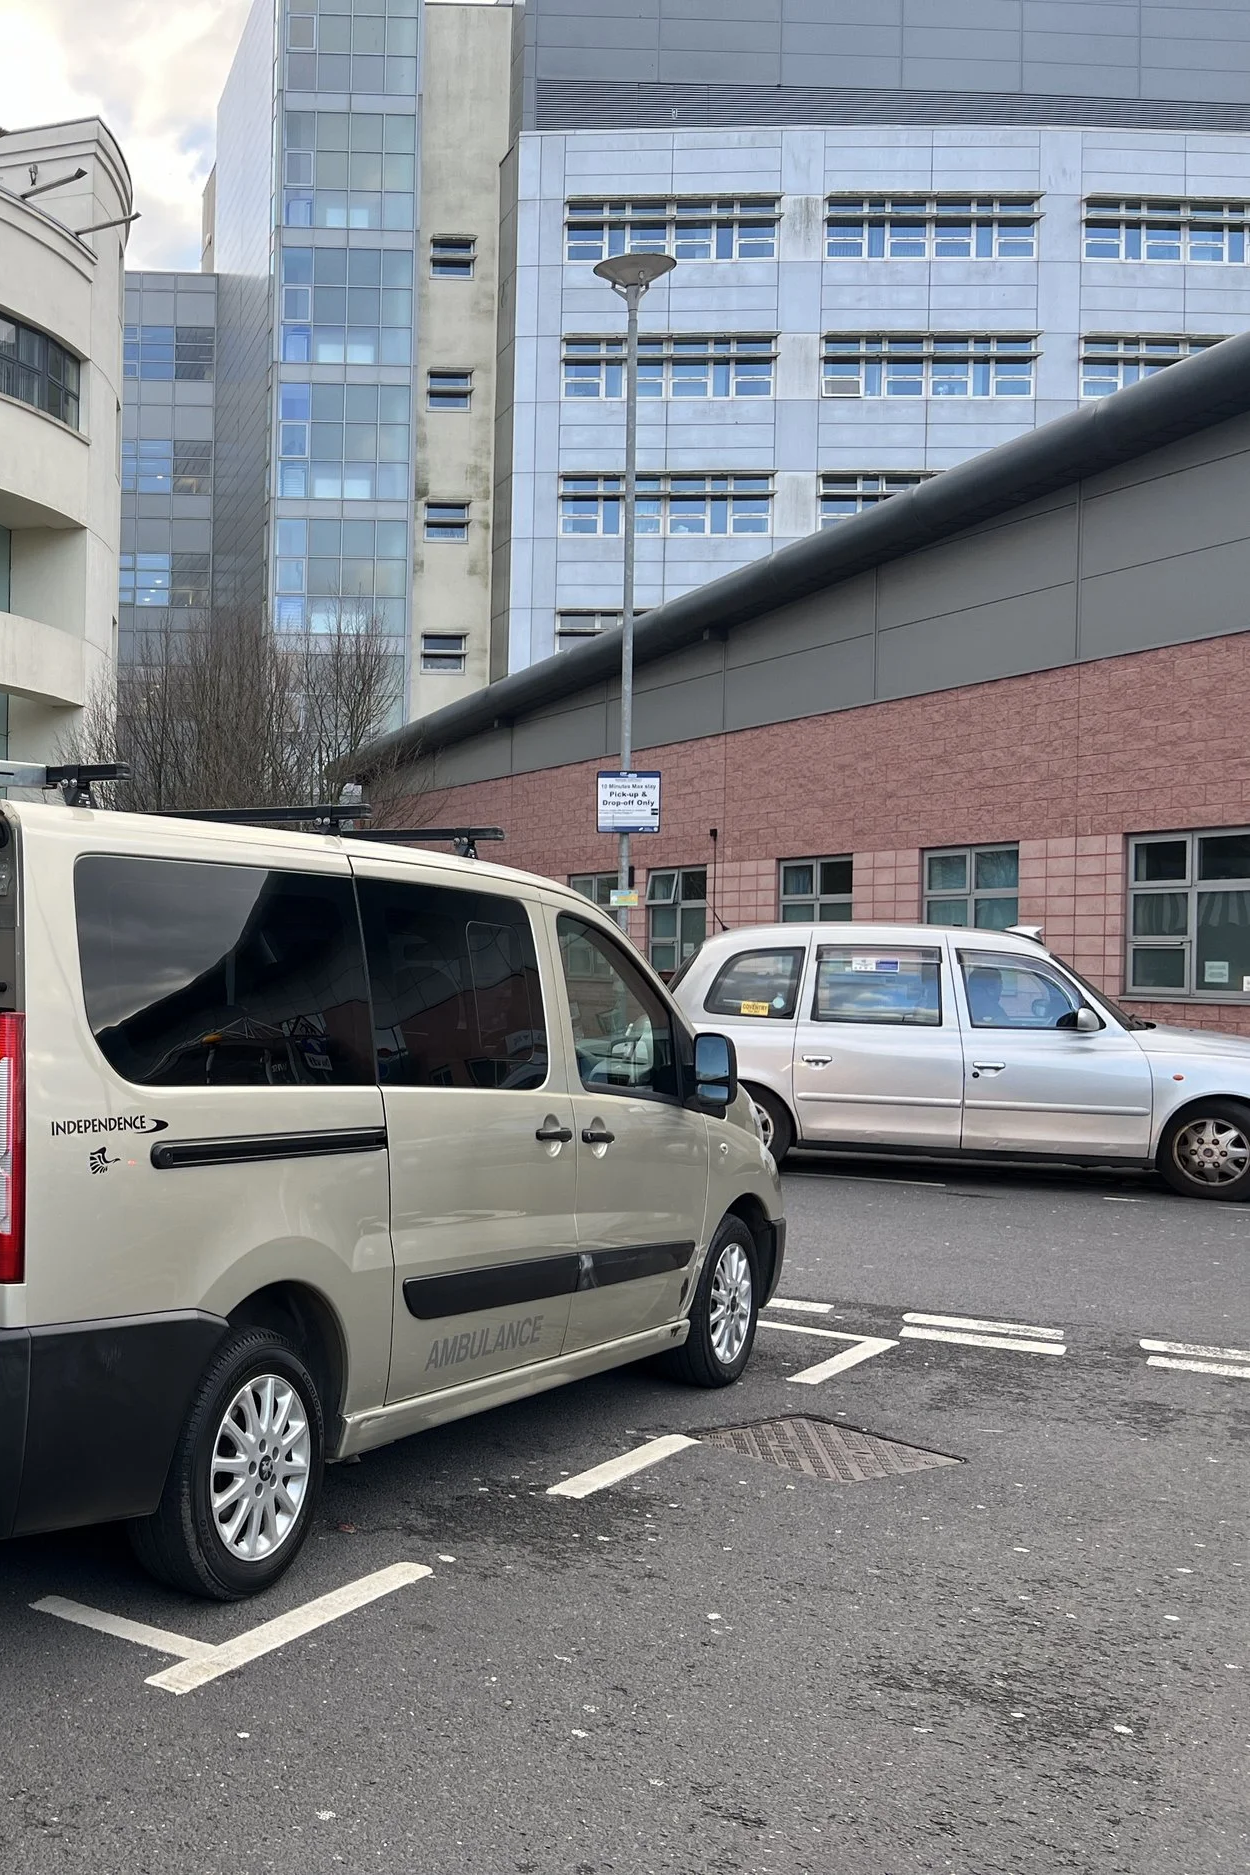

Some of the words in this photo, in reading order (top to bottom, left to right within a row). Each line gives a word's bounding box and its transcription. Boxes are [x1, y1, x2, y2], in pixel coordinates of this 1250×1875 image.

[602, 799, 634, 807] Drop-off
[636, 799, 655, 807] Only
[51, 1115, 147, 1136] INDEPENDENCE
[424, 1315, 544, 1372] AMBULANCE
